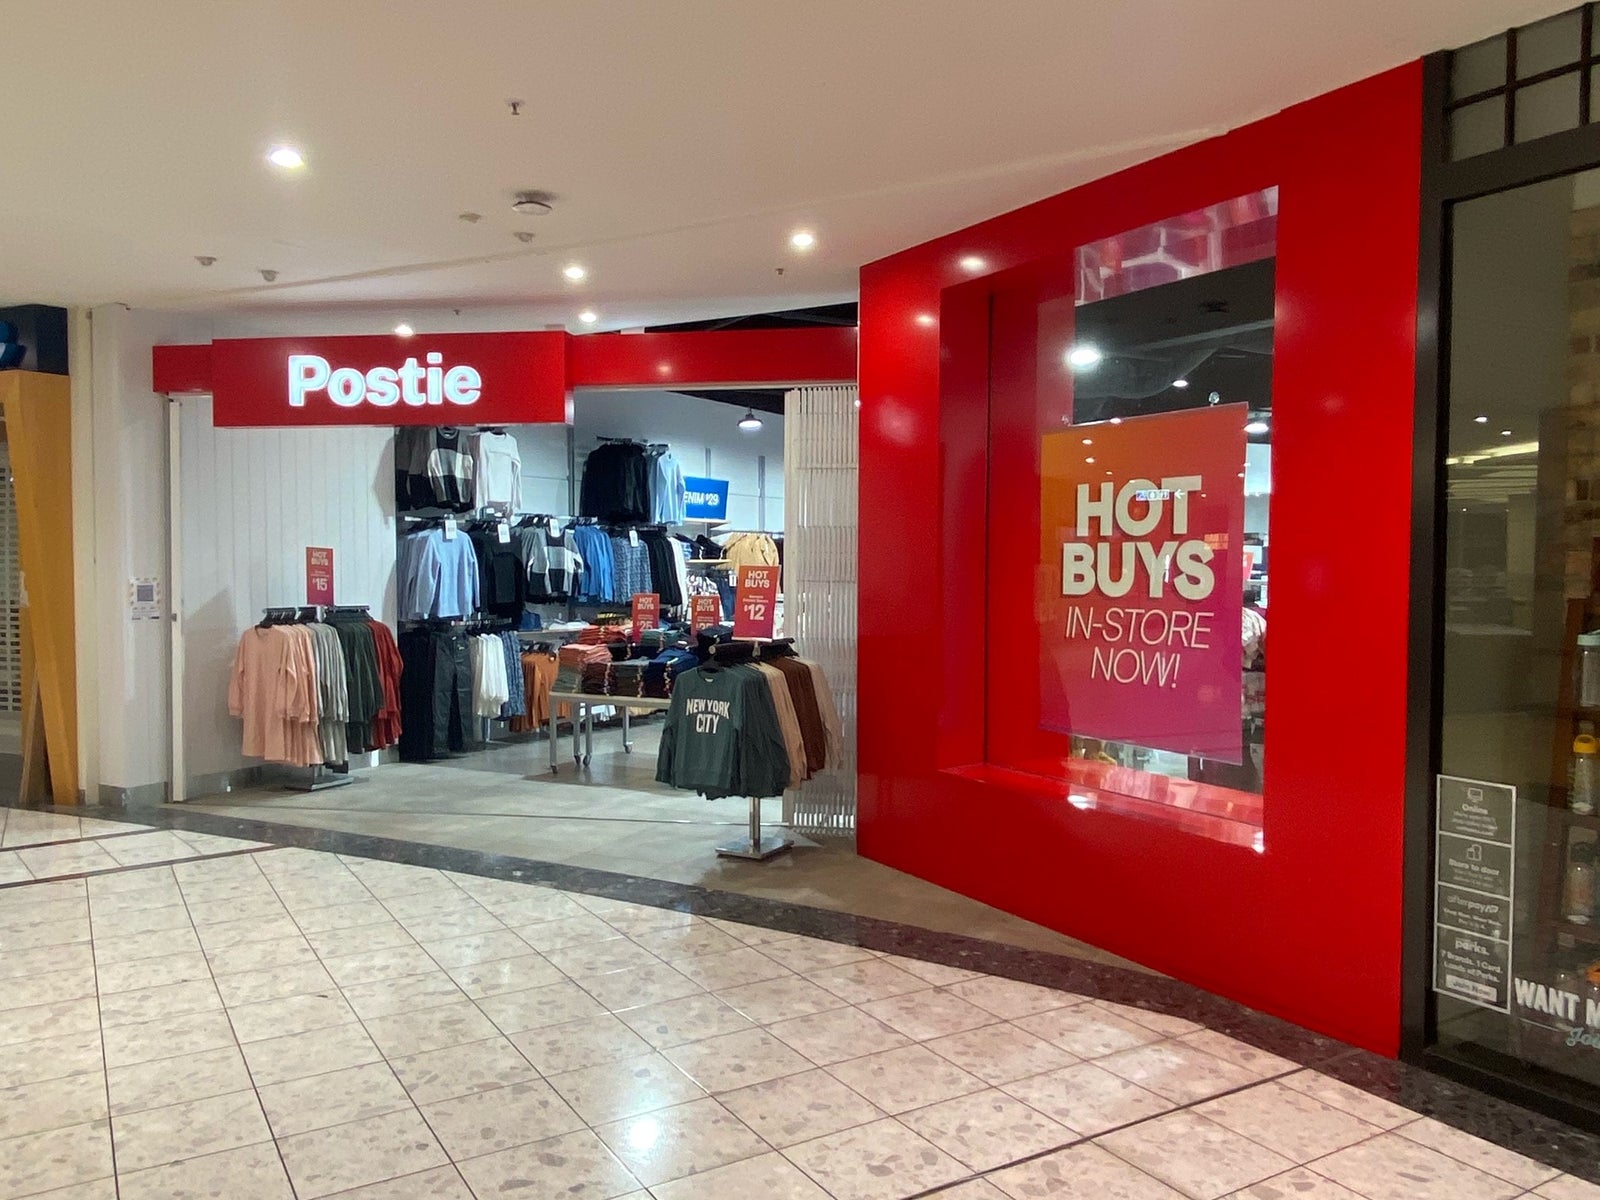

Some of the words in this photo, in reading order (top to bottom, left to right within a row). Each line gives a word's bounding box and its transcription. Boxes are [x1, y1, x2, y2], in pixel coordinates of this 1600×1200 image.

[288, 352, 482, 407] Postie
[683, 491, 704, 505] ENIM
[705, 493, 720, 506] $29
[1076, 475, 1202, 537] HOT
[748, 570, 769, 580] HOT
[1062, 540, 1215, 600] BUYS
[312, 577, 328, 591] $15
[745, 579, 770, 589] BUYS
[743, 604, 766, 621] $12
[1066, 606, 1214, 649] IN-STORE
[1091, 646, 1180, 688] NOW!
[685, 698, 706, 716] NEW
[706, 699, 730, 720] YORK
[696, 713, 720, 734] CITY
[1446, 895, 1486, 914] afterpay
[1514, 977, 1580, 1022] WANT
[1586, 998, 1600, 1030] M
